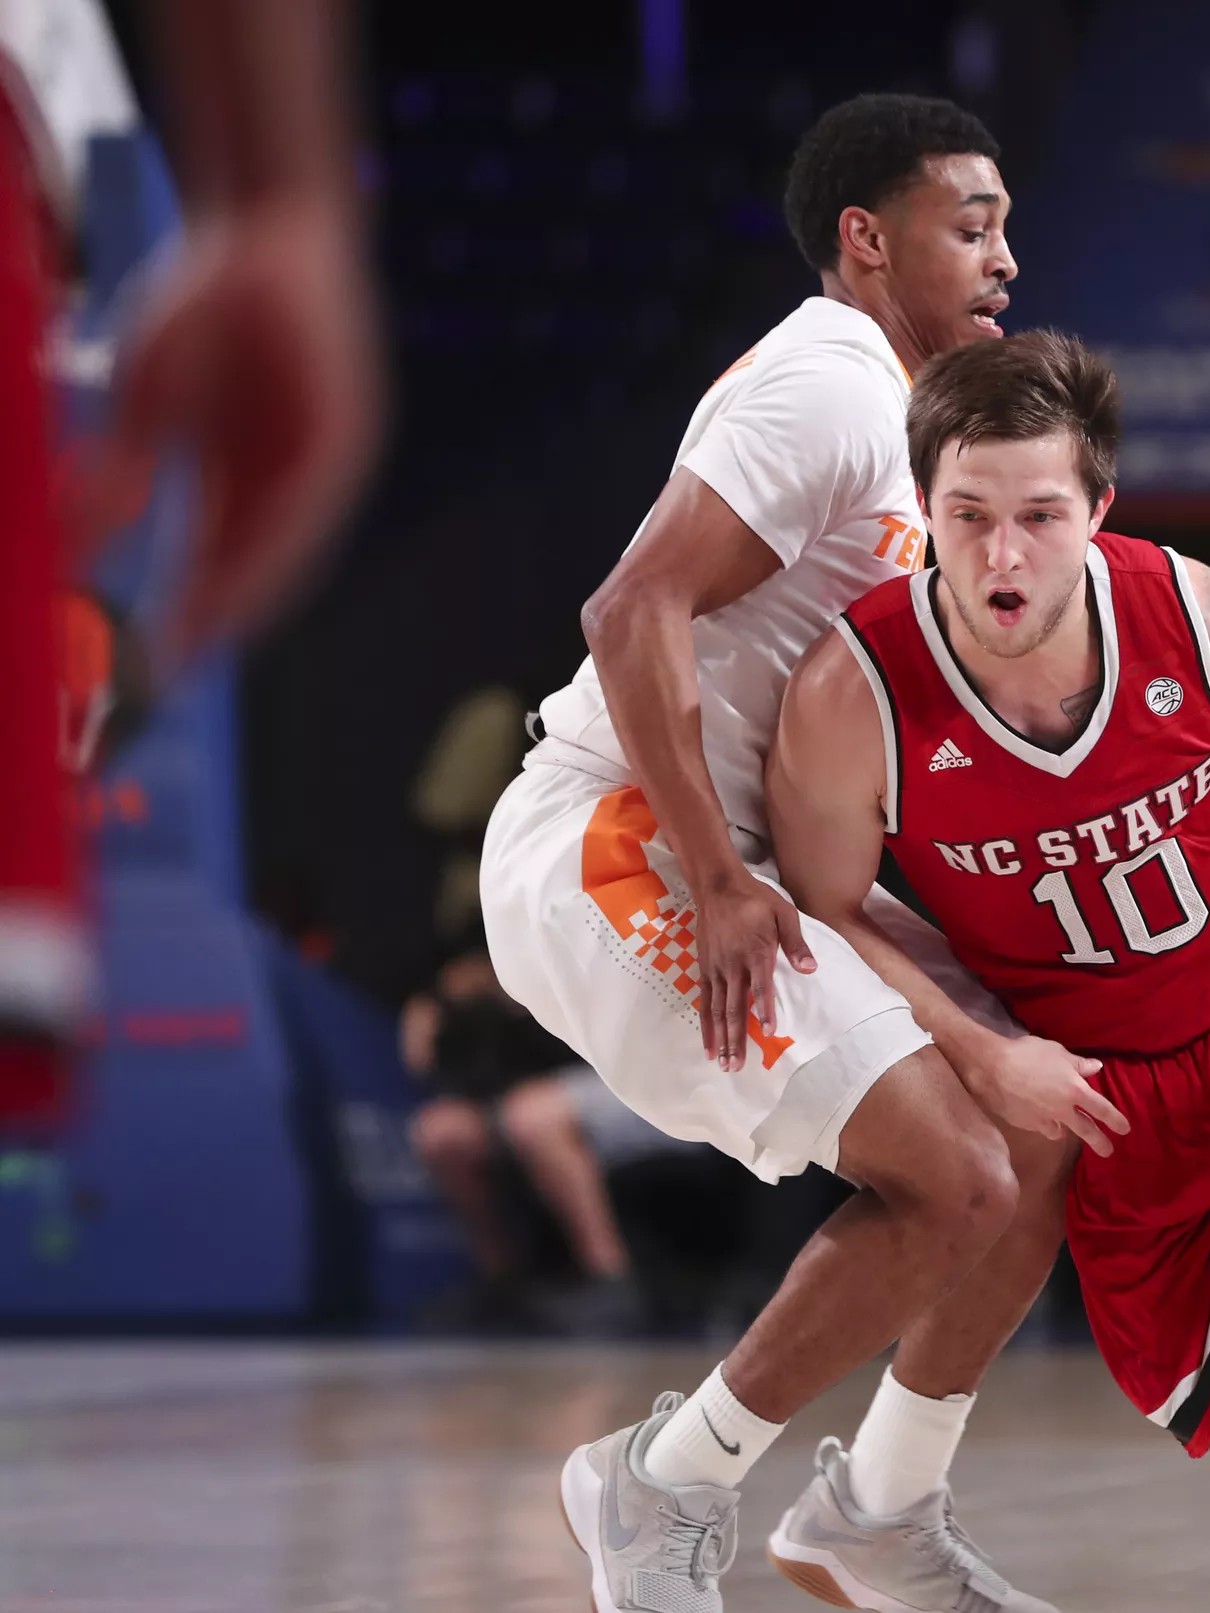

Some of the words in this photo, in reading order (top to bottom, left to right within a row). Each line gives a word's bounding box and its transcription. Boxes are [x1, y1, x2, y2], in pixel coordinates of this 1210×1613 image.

[1152, 685, 1179, 703] ACC
[928, 756, 973, 773] adidas
[931, 838, 1023, 876] NC
[1031, 836, 1210, 964] 10
